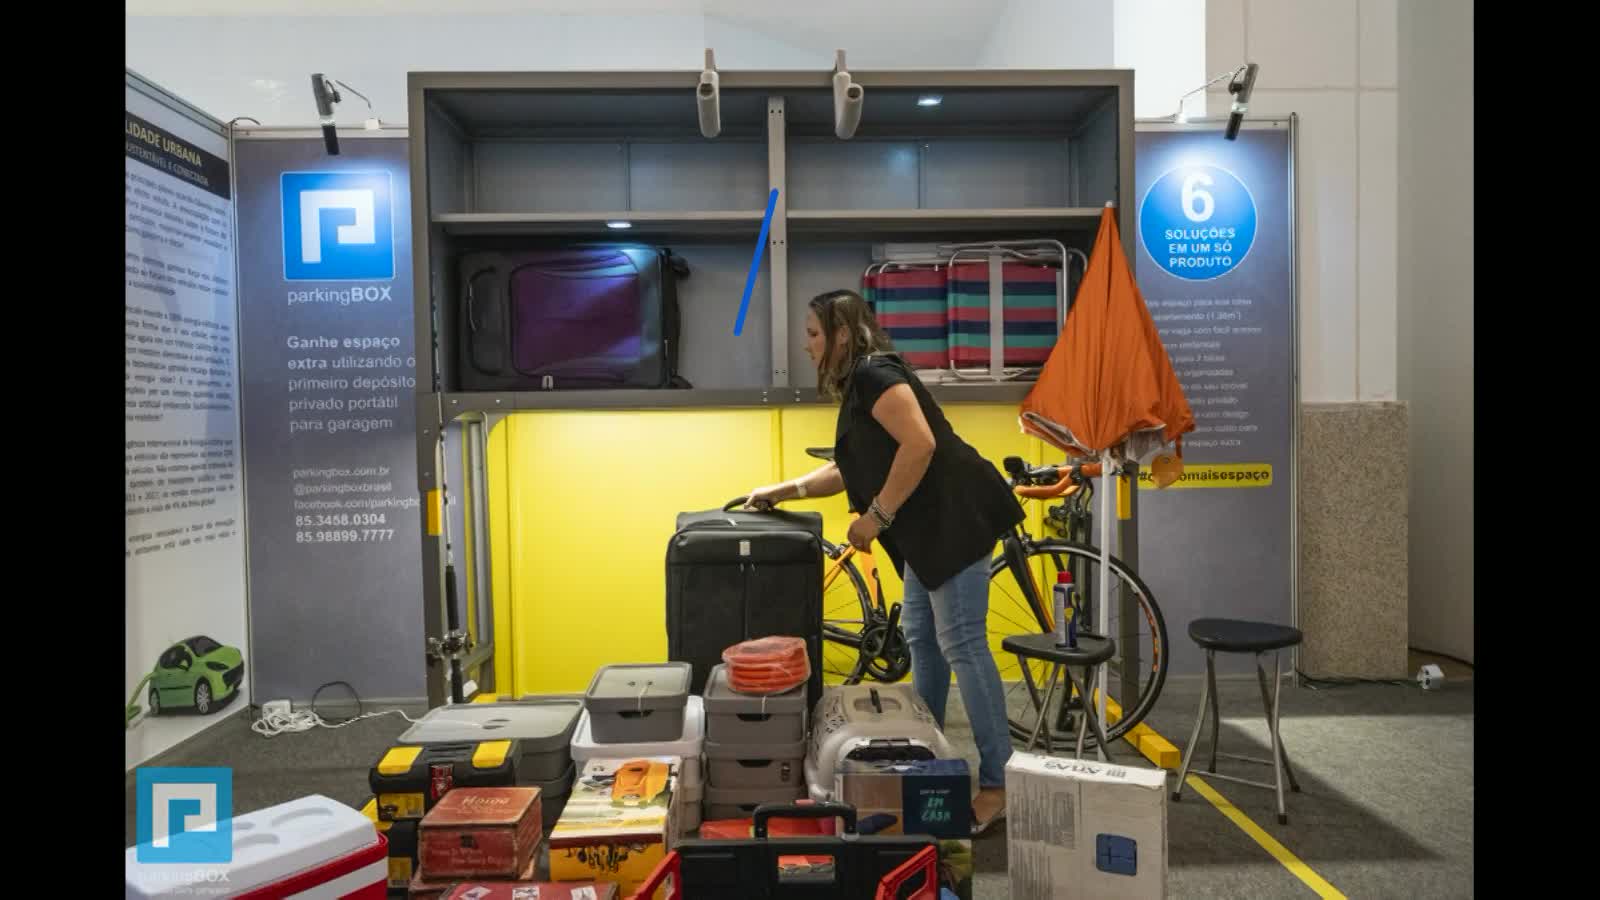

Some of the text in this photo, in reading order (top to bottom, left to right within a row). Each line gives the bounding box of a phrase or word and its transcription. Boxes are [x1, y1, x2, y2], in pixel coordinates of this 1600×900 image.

[162, 137, 202, 167] URBANA
[1181, 173, 1215, 222] 6
[1165, 227, 1235, 240] SOLUÇÕES
[1168, 240, 1232, 254] EM UM SÓ
[1169, 256, 1232, 267] PRODUTO
[287, 286, 392, 305] parkingBOX
[287, 336, 400, 349] Ganhe espaço
[288, 355, 416, 370] extra utilizando o
[288, 375, 416, 392] primeiro depósito
[289, 396, 398, 412] privado portátil
[290, 419, 393, 434] para garagem
[293, 467, 390, 479] parkingbox.com.br
[295, 513, 386, 526] 85.3458.0304
